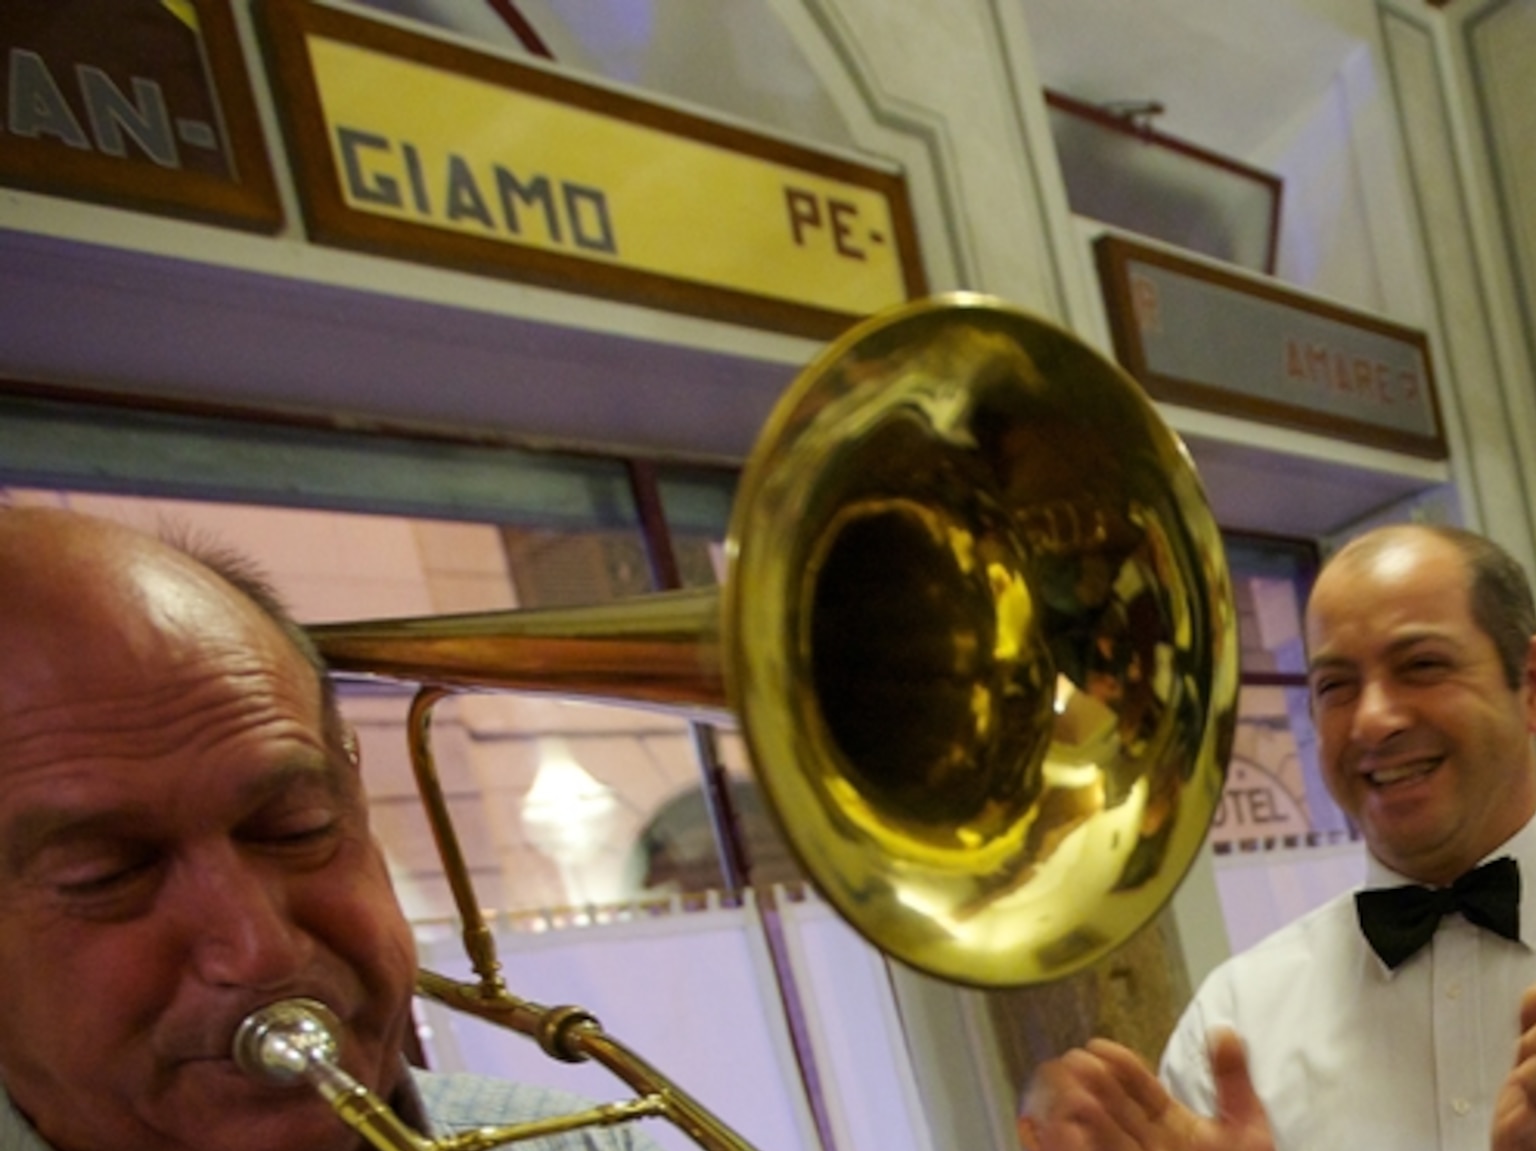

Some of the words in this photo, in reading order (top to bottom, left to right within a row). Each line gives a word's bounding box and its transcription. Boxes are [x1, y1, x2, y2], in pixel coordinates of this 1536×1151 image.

[0, 47, 218, 170] AN-
[336, 124, 618, 255] GIAMO
[784, 185, 884, 261] PE-
[1211, 786, 1290, 828] OTEL
